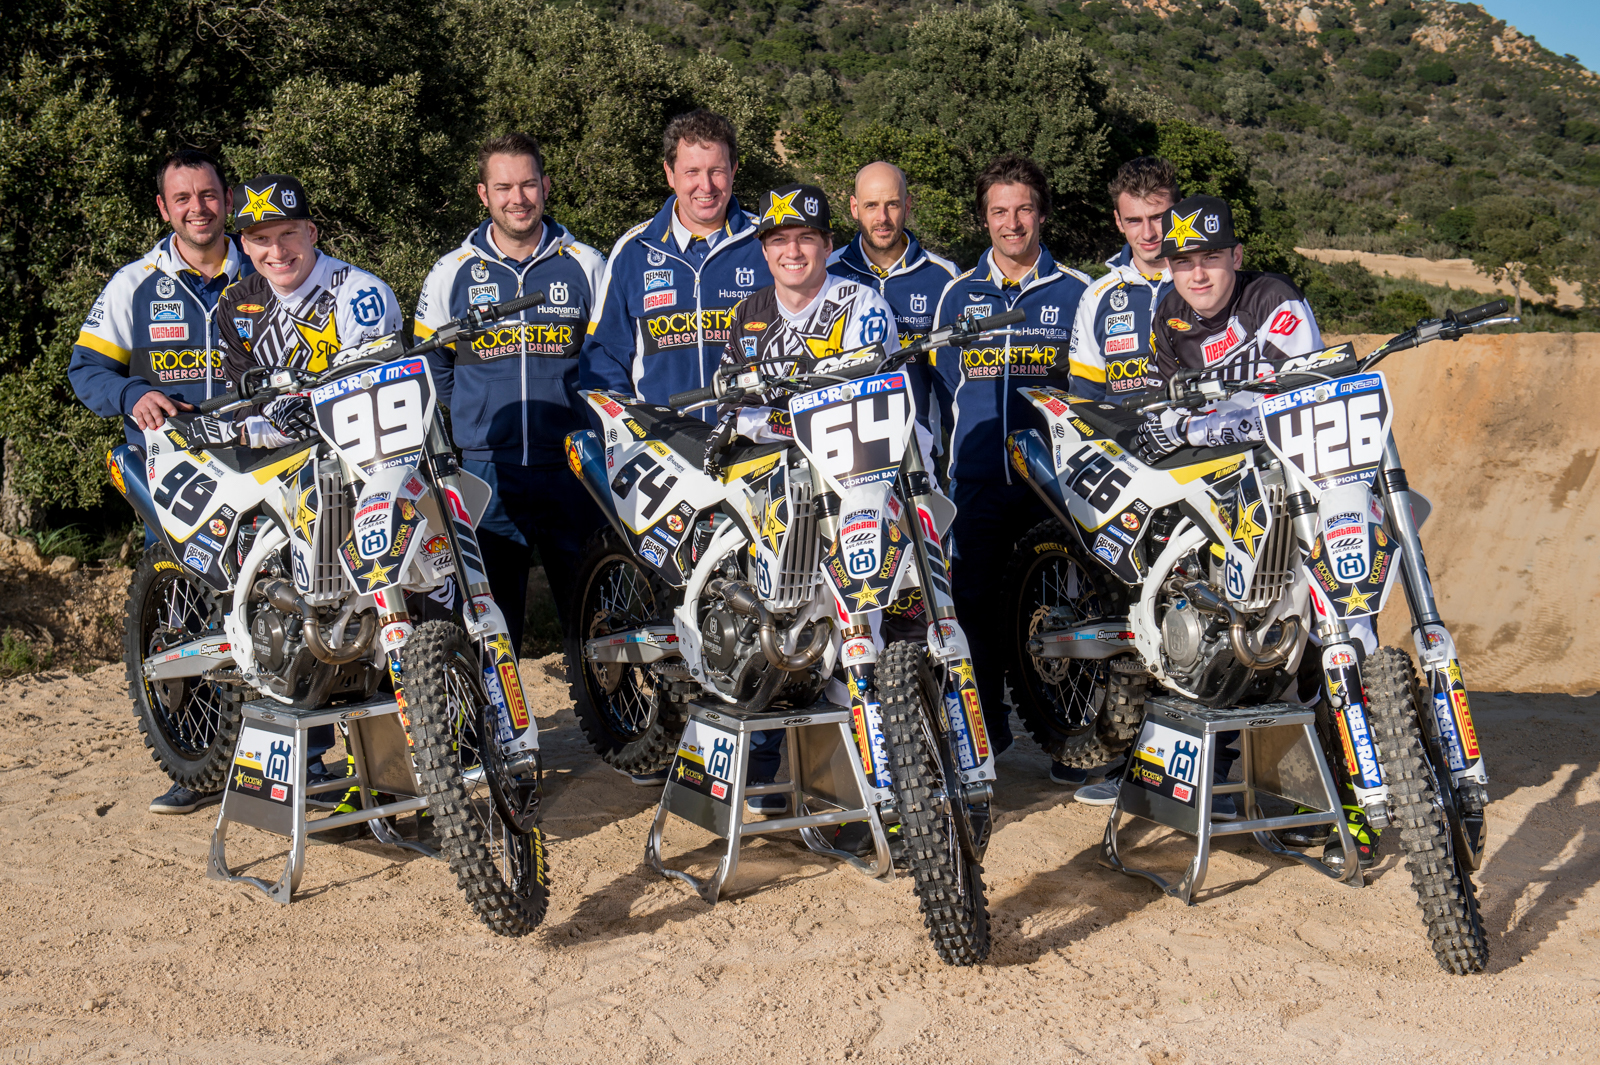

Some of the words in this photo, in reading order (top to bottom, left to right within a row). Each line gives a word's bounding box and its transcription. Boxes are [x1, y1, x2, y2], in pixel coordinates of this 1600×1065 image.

[537, 305, 580, 315] Husqvarna
[644, 292, 673, 309] nestaan
[150, 326, 185, 339] nestaan
[471, 325, 573, 351] ROCKSTAR
[658, 332, 698, 347] ENERGY
[1022, 327, 1067, 337] Husqvarna
[479, 344, 522, 358] ENERGY
[529, 342, 563, 353] DRINK
[1106, 336, 1136, 353] nestaan
[963, 346, 1057, 367] ROCKSTAR
[160, 368, 206, 380] ENERGY
[386, 361, 422, 381] MX2
[968, 366, 1004, 376] ENERGY
[1011, 364, 1048, 375] DRINK
[1106, 357, 1149, 381] ROCK
[867, 375, 904, 394] MX2
[332, 379, 424, 465] 99
[625, 419, 647, 439] JUMBO
[1070, 418, 1095, 437] JUMBO
[168, 430, 187, 448] JUMBO
[810, 392, 906, 479] 64
[1279, 393, 1383, 478] 426
[366, 459, 402, 475] SCORPION
[404, 453, 420, 463] BAY
[611, 451, 679, 521] 64
[842, 473, 880, 488] SCORPION
[881, 469, 898, 480] BAY
[1065, 444, 1132, 515] 426
[1318, 473, 1358, 490] SCORPION
[1359, 470, 1377, 481] BAY
[153, 460, 218, 527] 99
[354, 502, 390, 520] nestaan
[841, 520, 878, 537] nestaan
[1326, 526, 1362, 541] nestaan
[1034, 543, 1068, 555] PIRELLI
[153, 561, 185, 574] PIRELLI
[879, 545, 899, 579] ROCKSTAR
[1368, 551, 1387, 584] ROCKSTAR
[1316, 560, 1339, 591] ROCKSTAR
[502, 665, 529, 726] PIRELLI
[965, 691, 989, 755] PIRELLI
[1454, 692, 1480, 756] PIRELLI
[532, 827, 544, 887] PIRELLI
